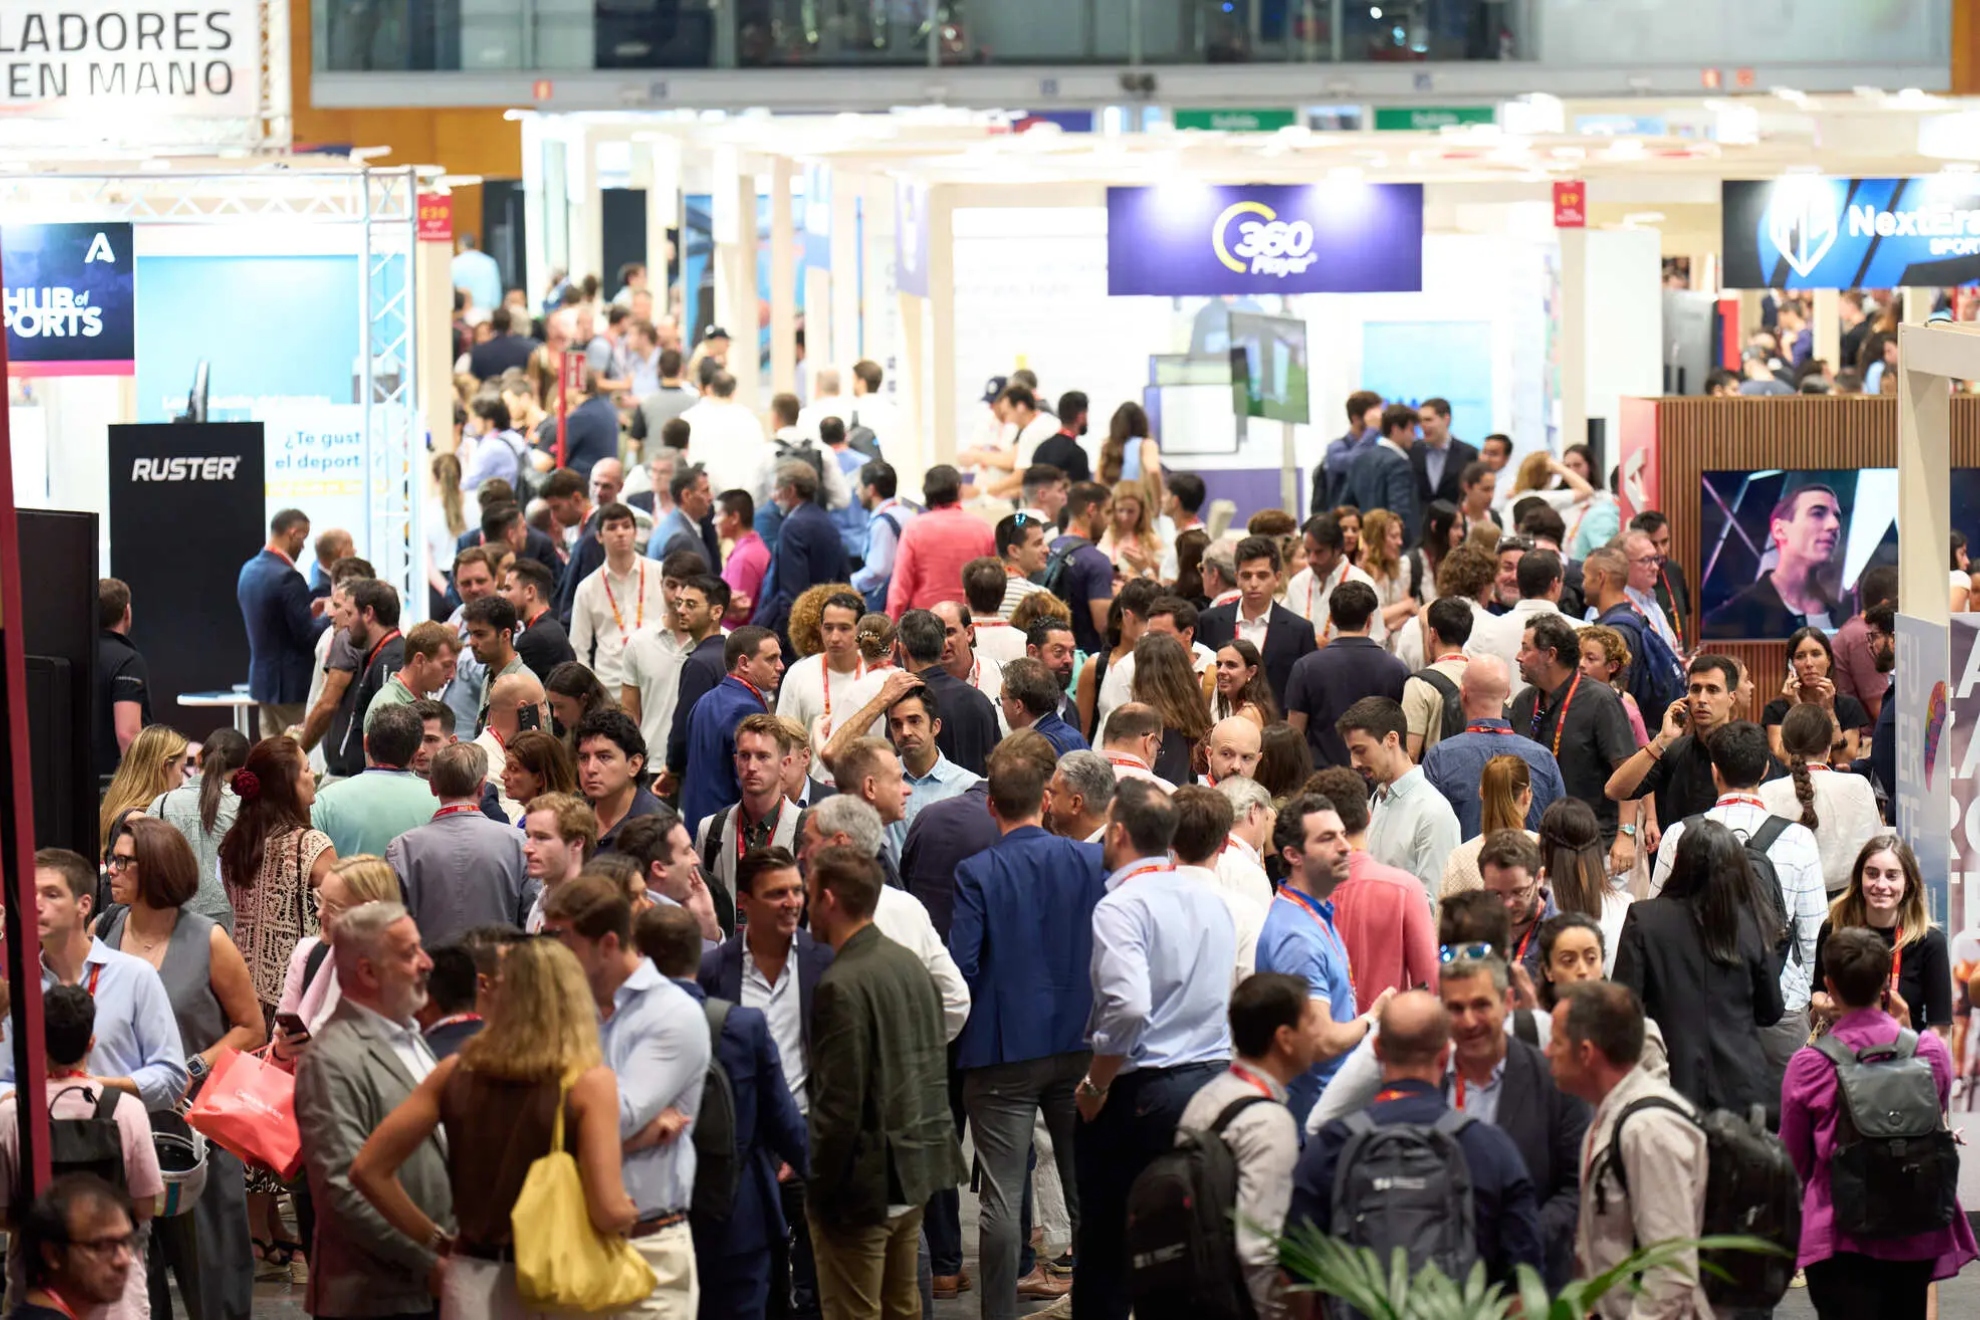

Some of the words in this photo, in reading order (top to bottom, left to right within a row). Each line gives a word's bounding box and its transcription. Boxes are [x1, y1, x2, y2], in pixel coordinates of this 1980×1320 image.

[9, 62, 67, 97] EN
[89, 61, 233, 95] MANO
[1233, 220, 1314, 258] 360
[1929, 237, 1980, 255] SPOR
[2, 287, 75, 312] HUB
[321, 431, 361, 448] gust
[131, 456, 237, 482] RUSTER
[275, 453, 291, 469] el
